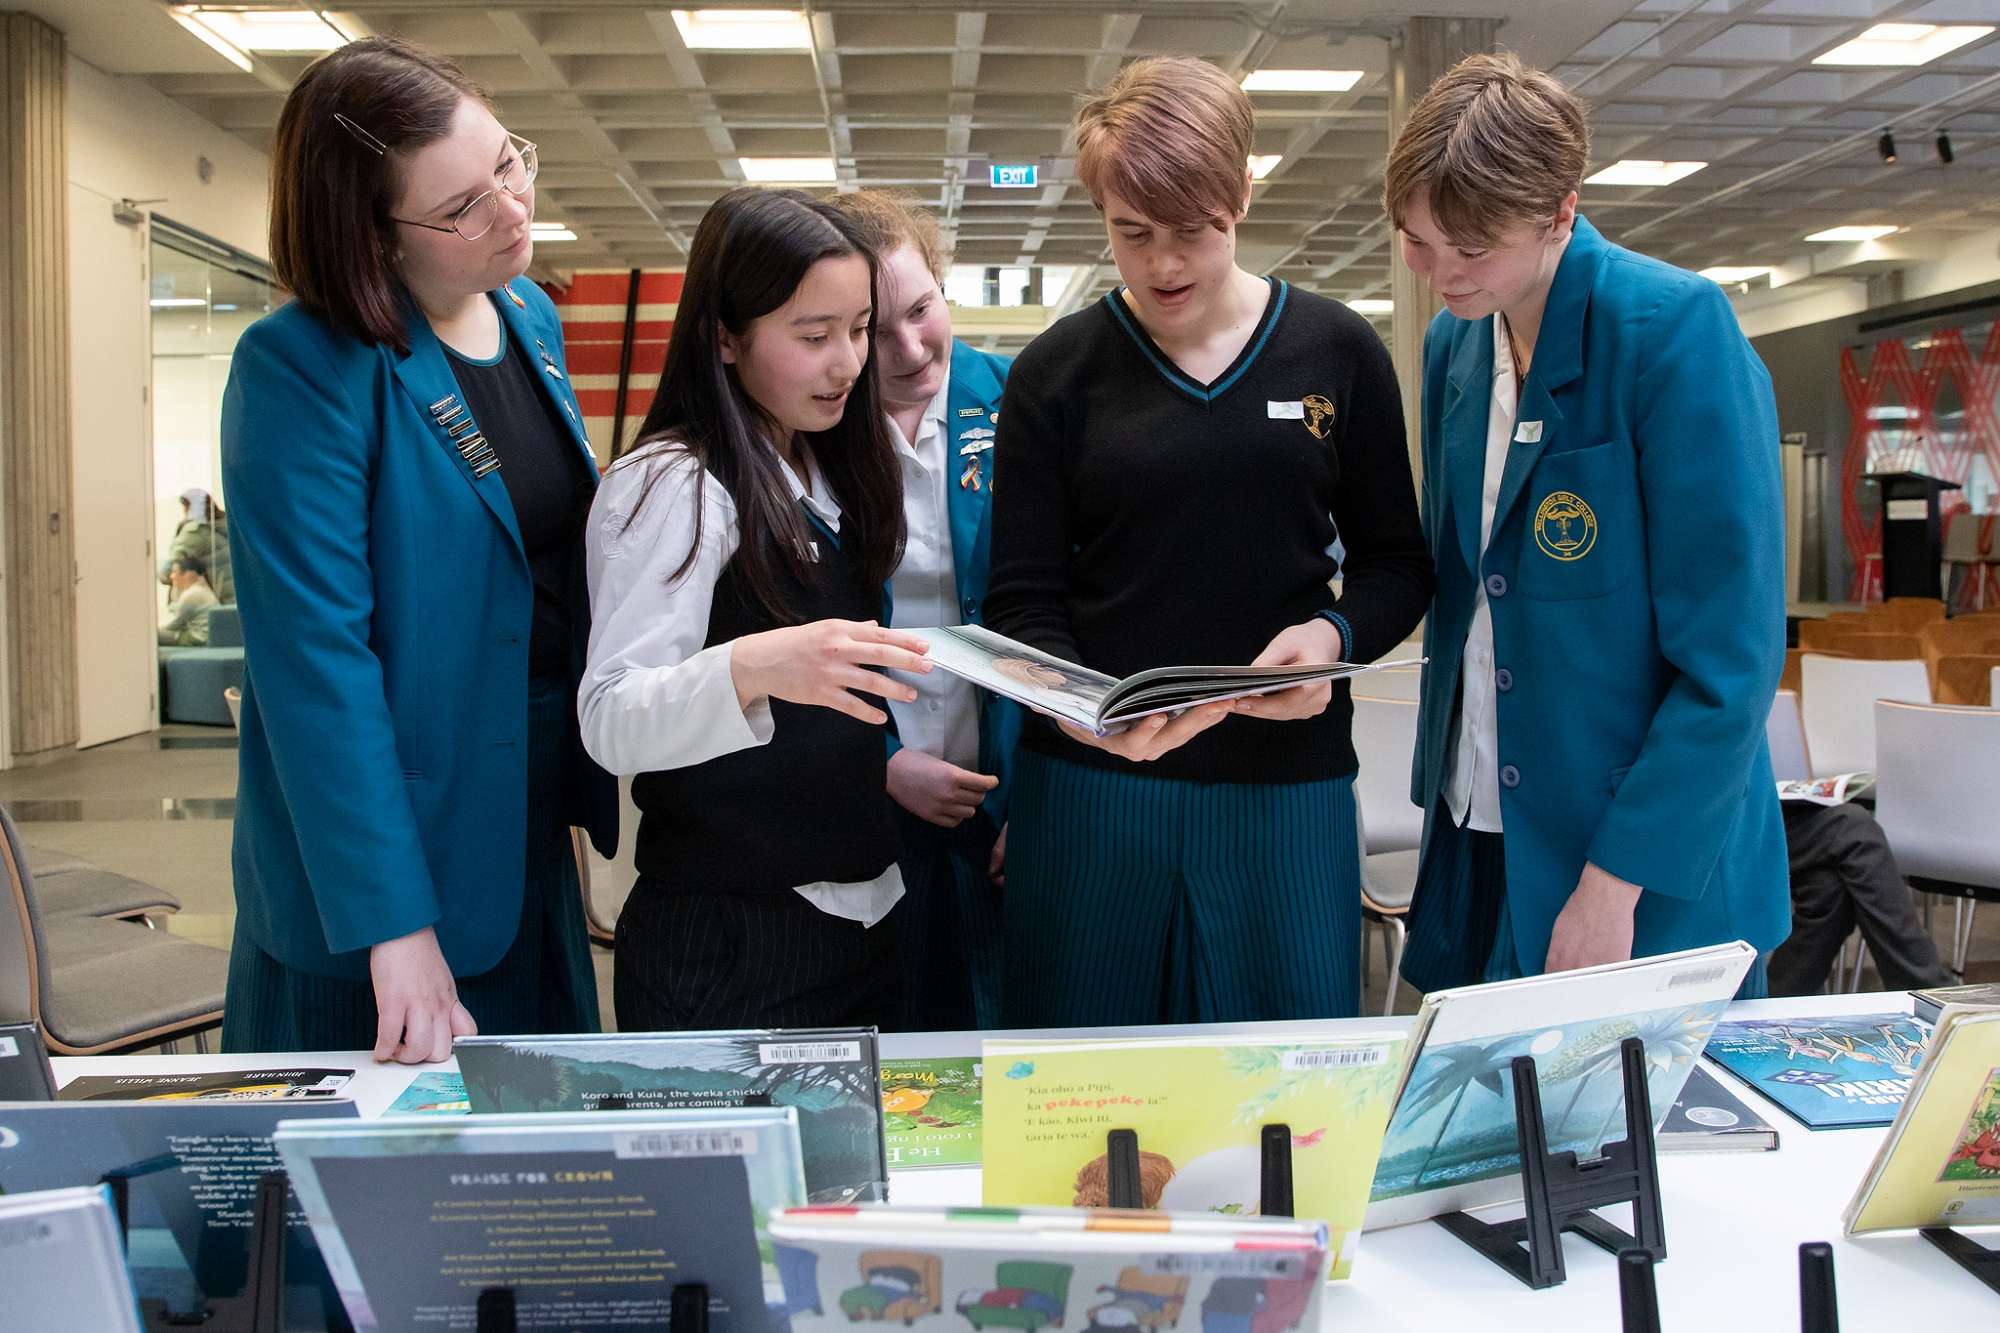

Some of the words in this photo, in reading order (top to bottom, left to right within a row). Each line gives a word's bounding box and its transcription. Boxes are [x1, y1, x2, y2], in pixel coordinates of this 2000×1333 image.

[999, 167, 1027, 184] EXIT
[581, 1091, 609, 1100] Koro
[612, 1090, 634, 1100] and
[670, 1089, 690, 1098] the
[692, 1088, 723, 1098] weka
[1814, 1078, 1913, 1098] ARIKI
[583, 1101, 664, 1110] graarents,
[667, 1100, 685, 1108] are
[688, 1099, 732, 1108] coming
[908, 1146, 941, 1157] He
[450, 1173, 511, 1185] PRAISE
[516, 1172, 549, 1184] FOR
[554, 1171, 614, 1182] CROWN
